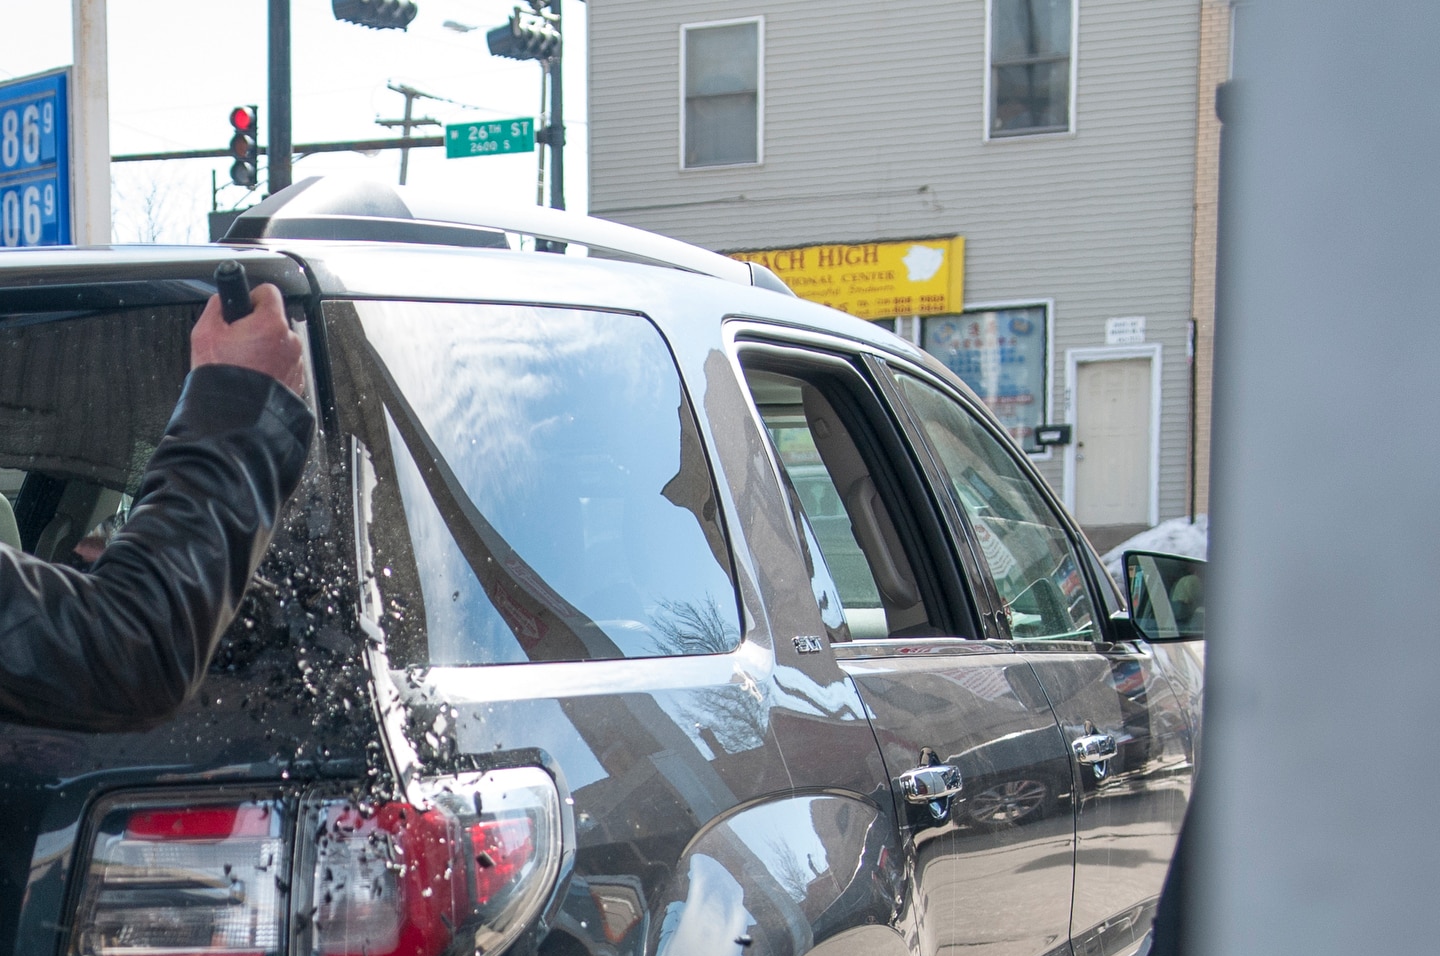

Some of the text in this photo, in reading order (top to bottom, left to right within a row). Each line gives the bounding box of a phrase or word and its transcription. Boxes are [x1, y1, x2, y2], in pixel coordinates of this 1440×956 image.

[450, 121, 529, 141] W 26TH ST
[470, 140, 511, 152] 2600 S
[818, 245, 879, 268] HIGH
[784, 270, 895, 286] TIONAL CENTER
